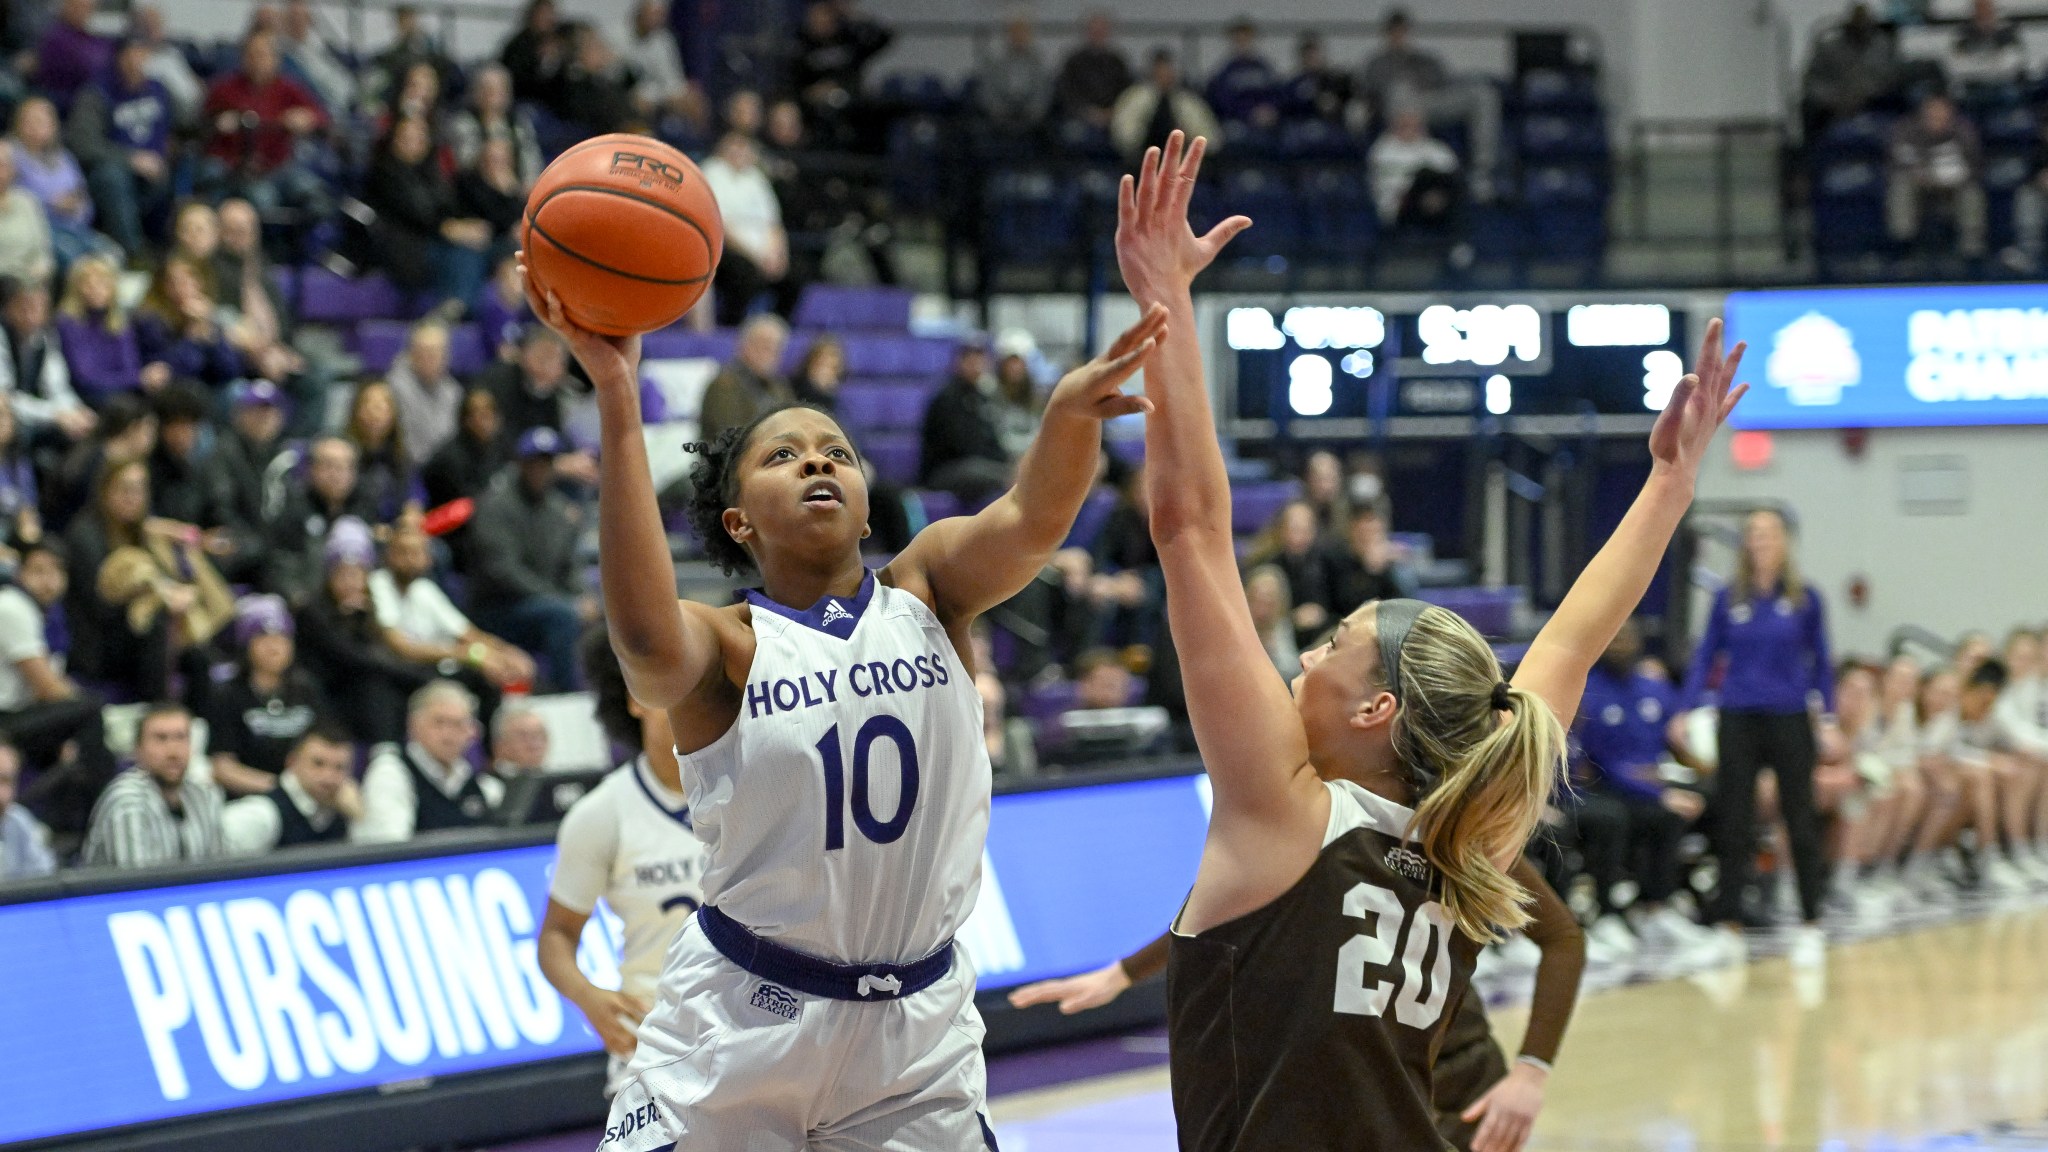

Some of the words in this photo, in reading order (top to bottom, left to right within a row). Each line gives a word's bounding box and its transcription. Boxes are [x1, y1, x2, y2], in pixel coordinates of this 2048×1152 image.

[613, 152, 684, 184] PRO
[822, 610, 854, 627] adidas
[747, 669, 838, 719] HOLY
[849, 652, 949, 698] CROSS
[815, 714, 920, 851] 10
[635, 858, 691, 887] HOLY
[1333, 881, 1456, 1031] 20
[108, 867, 563, 1101] PURSUING
[749, 998, 798, 1021] LEAGUE
[751, 992, 800, 1014] PATRIOT
